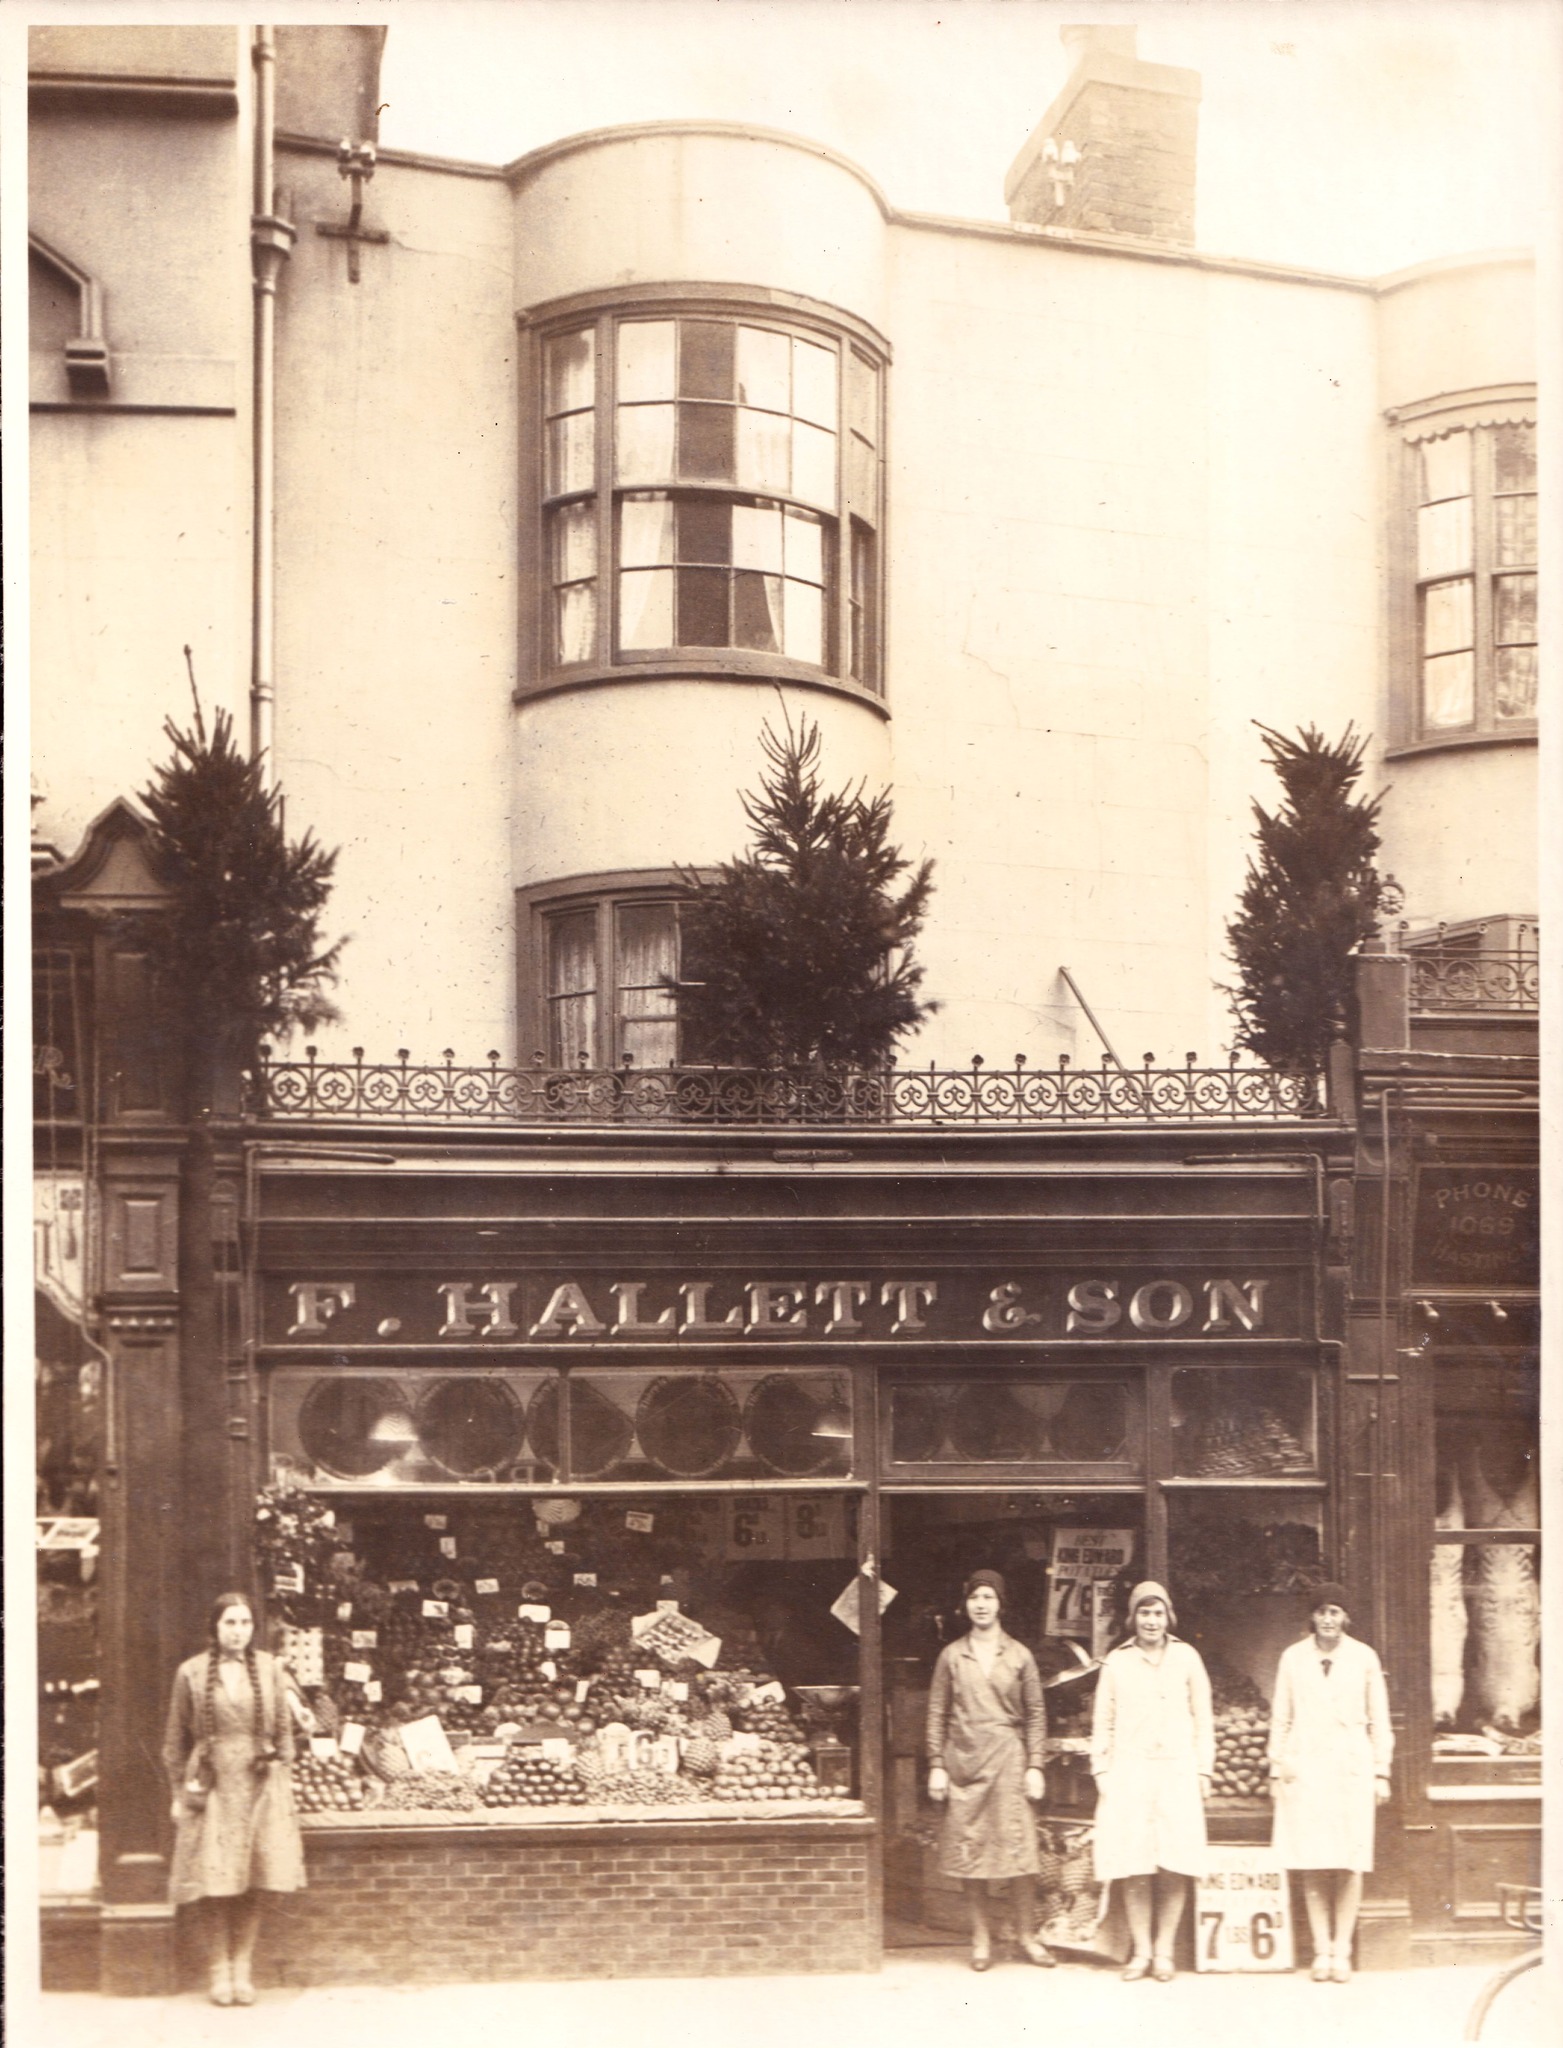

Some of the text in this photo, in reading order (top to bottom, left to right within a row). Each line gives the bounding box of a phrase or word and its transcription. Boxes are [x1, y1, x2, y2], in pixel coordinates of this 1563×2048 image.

[1433, 1182, 1532, 1208] PHONE
[287, 1279, 1271, 1336] F. HALLETT & SON
[1199, 1911, 1225, 1960] 7
